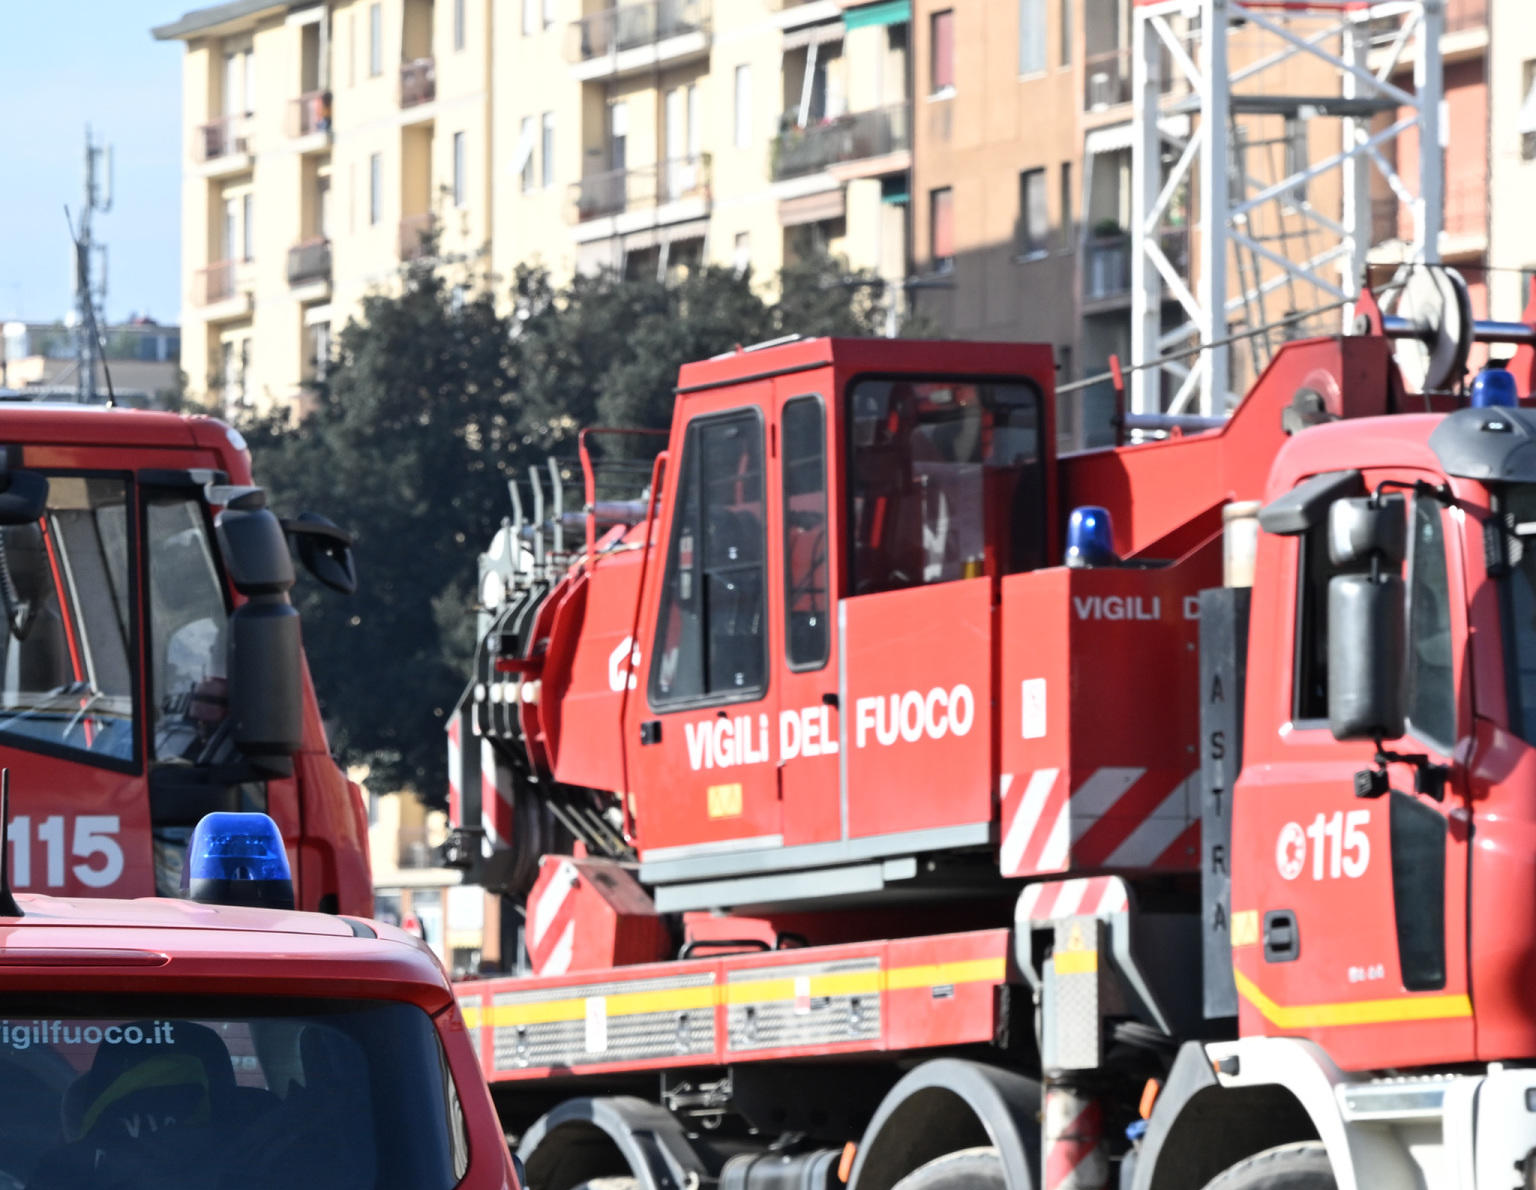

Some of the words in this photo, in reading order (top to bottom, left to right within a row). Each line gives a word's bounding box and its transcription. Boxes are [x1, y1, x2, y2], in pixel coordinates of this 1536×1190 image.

[1073, 595, 1161, 620] VIGILI
[779, 704, 839, 761] DEL
[855, 682, 975, 749] FUOCO
[1209, 673, 1229, 932] ASTRA
[7, 814, 125, 889] 115
[1306, 809, 1371, 880] 115
